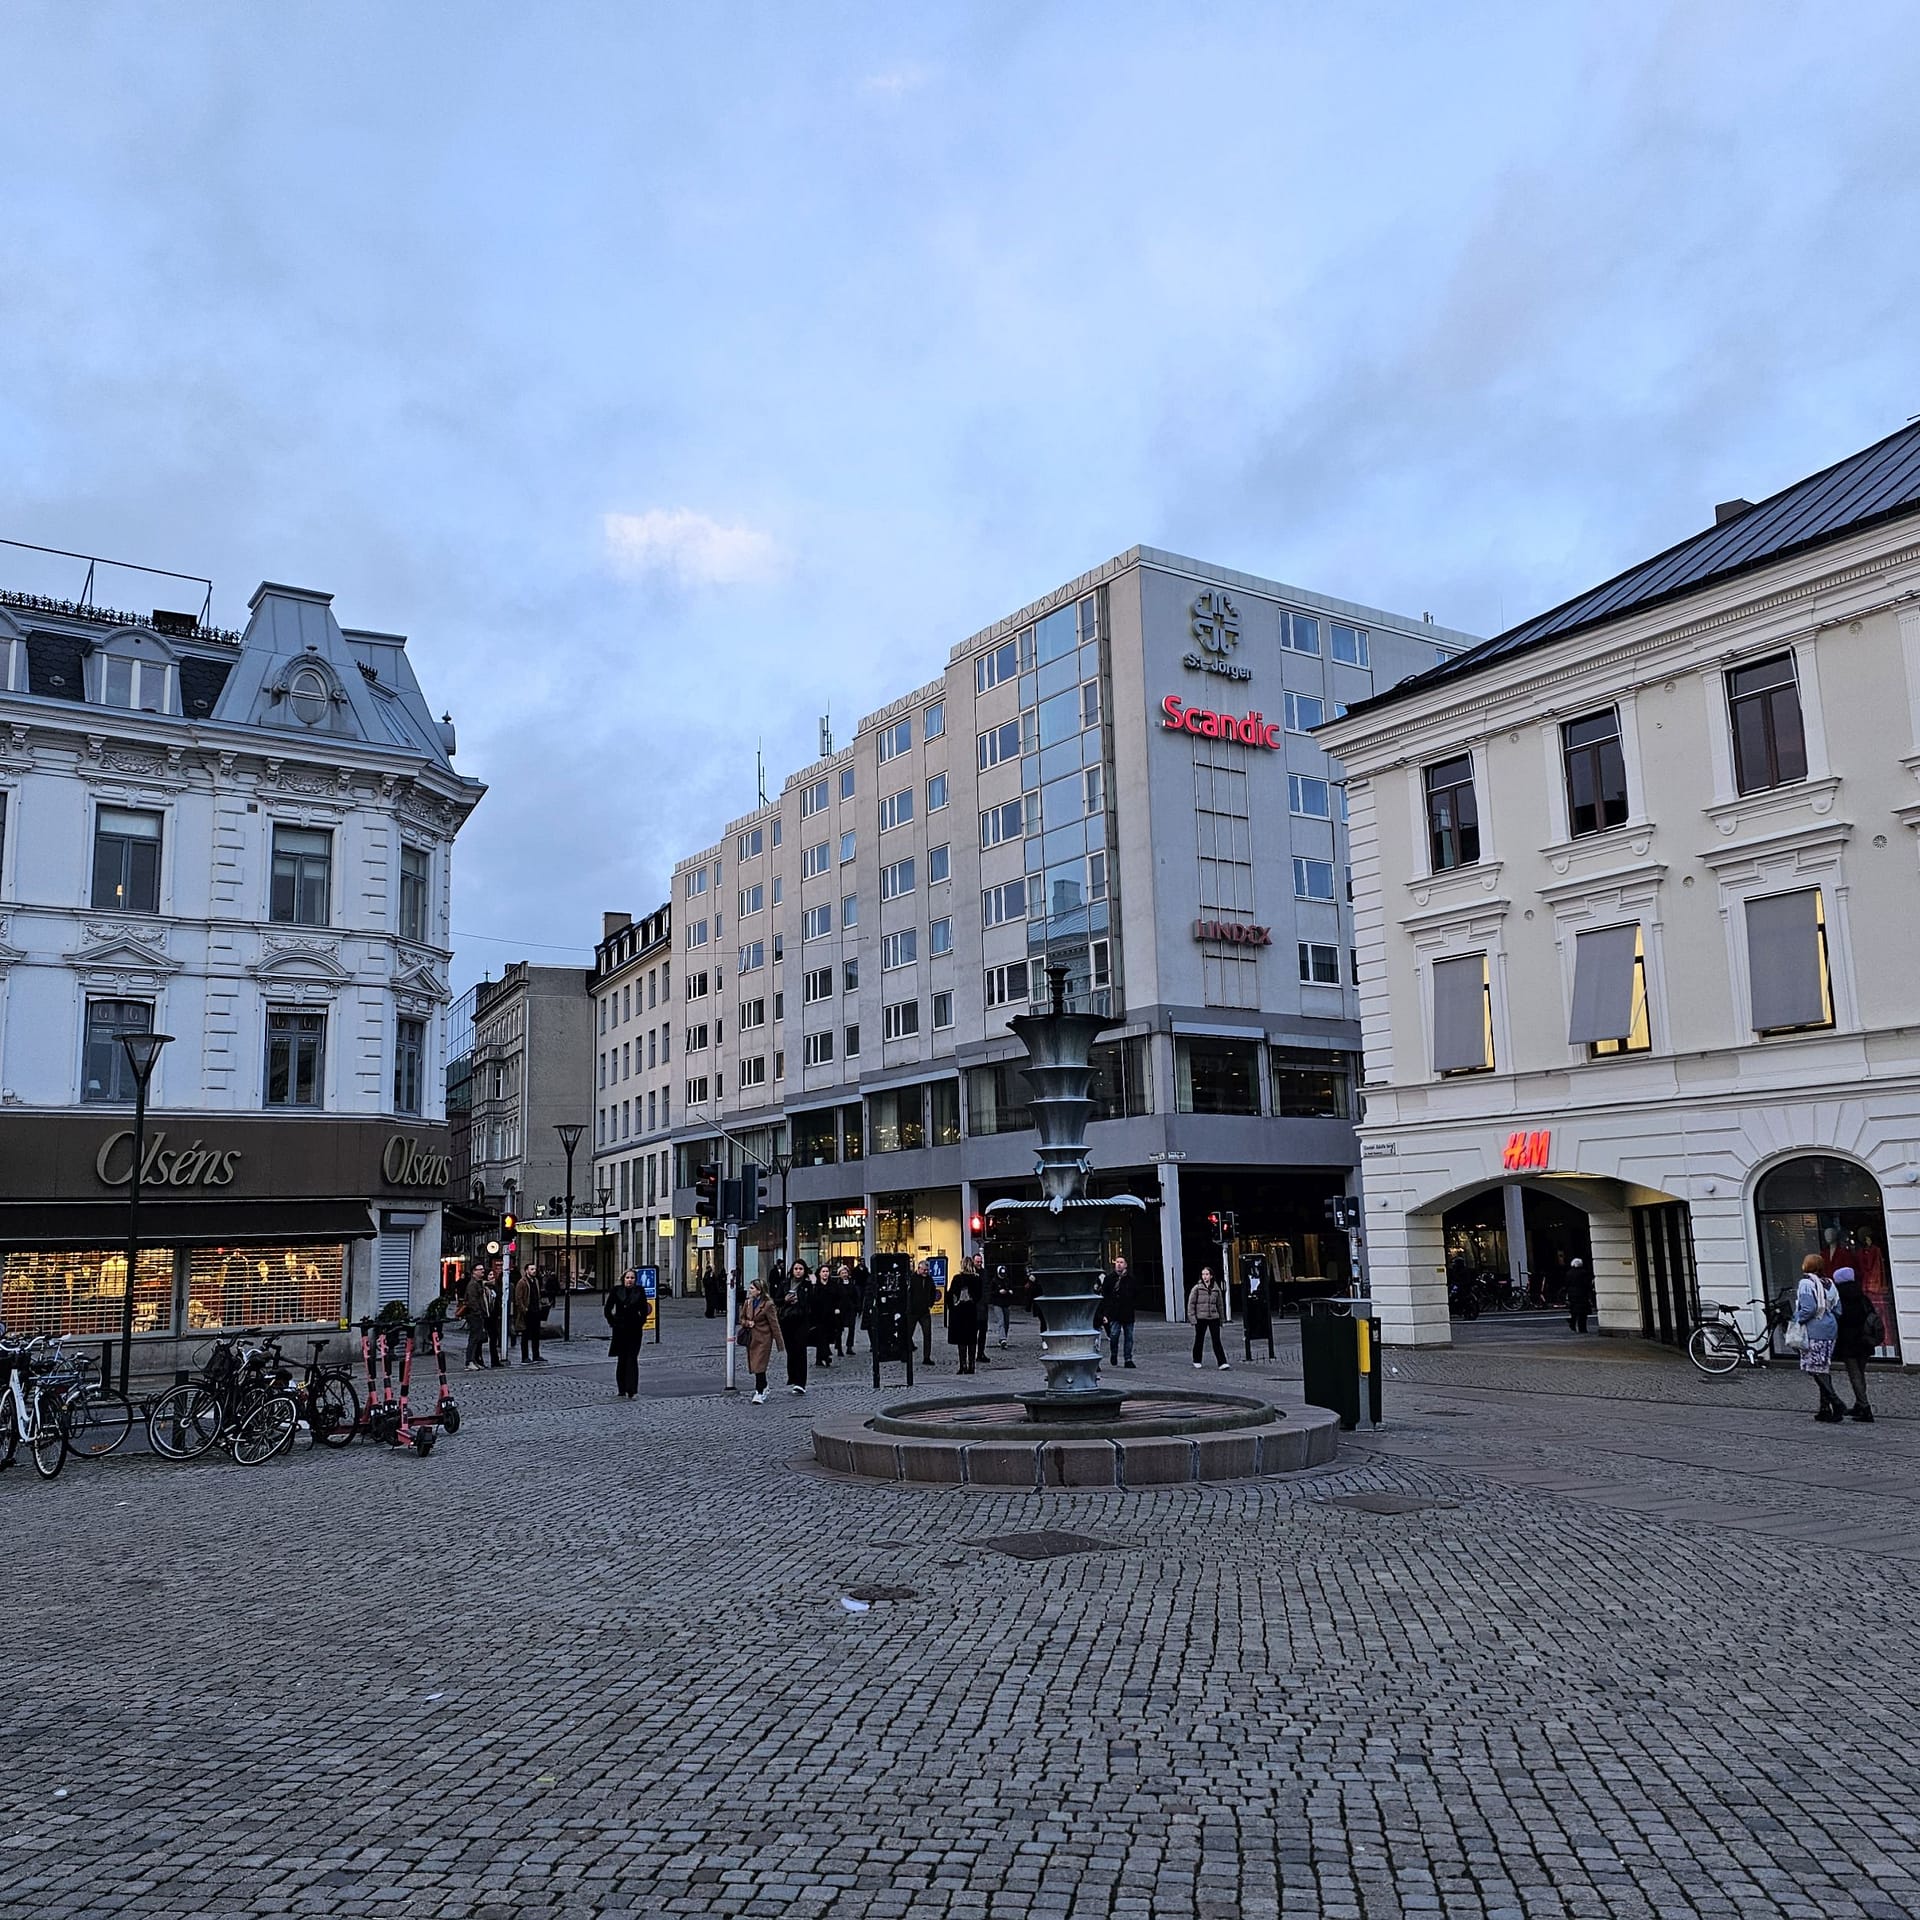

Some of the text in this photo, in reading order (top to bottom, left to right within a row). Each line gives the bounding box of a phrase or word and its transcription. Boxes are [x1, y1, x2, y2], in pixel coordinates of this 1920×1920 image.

[1162, 694, 1280, 749] Scandic
[1193, 919, 1272, 945] LINDEX
[96, 1130, 242, 1185] Olséns
[384, 1134, 453, 1186] Olséns
